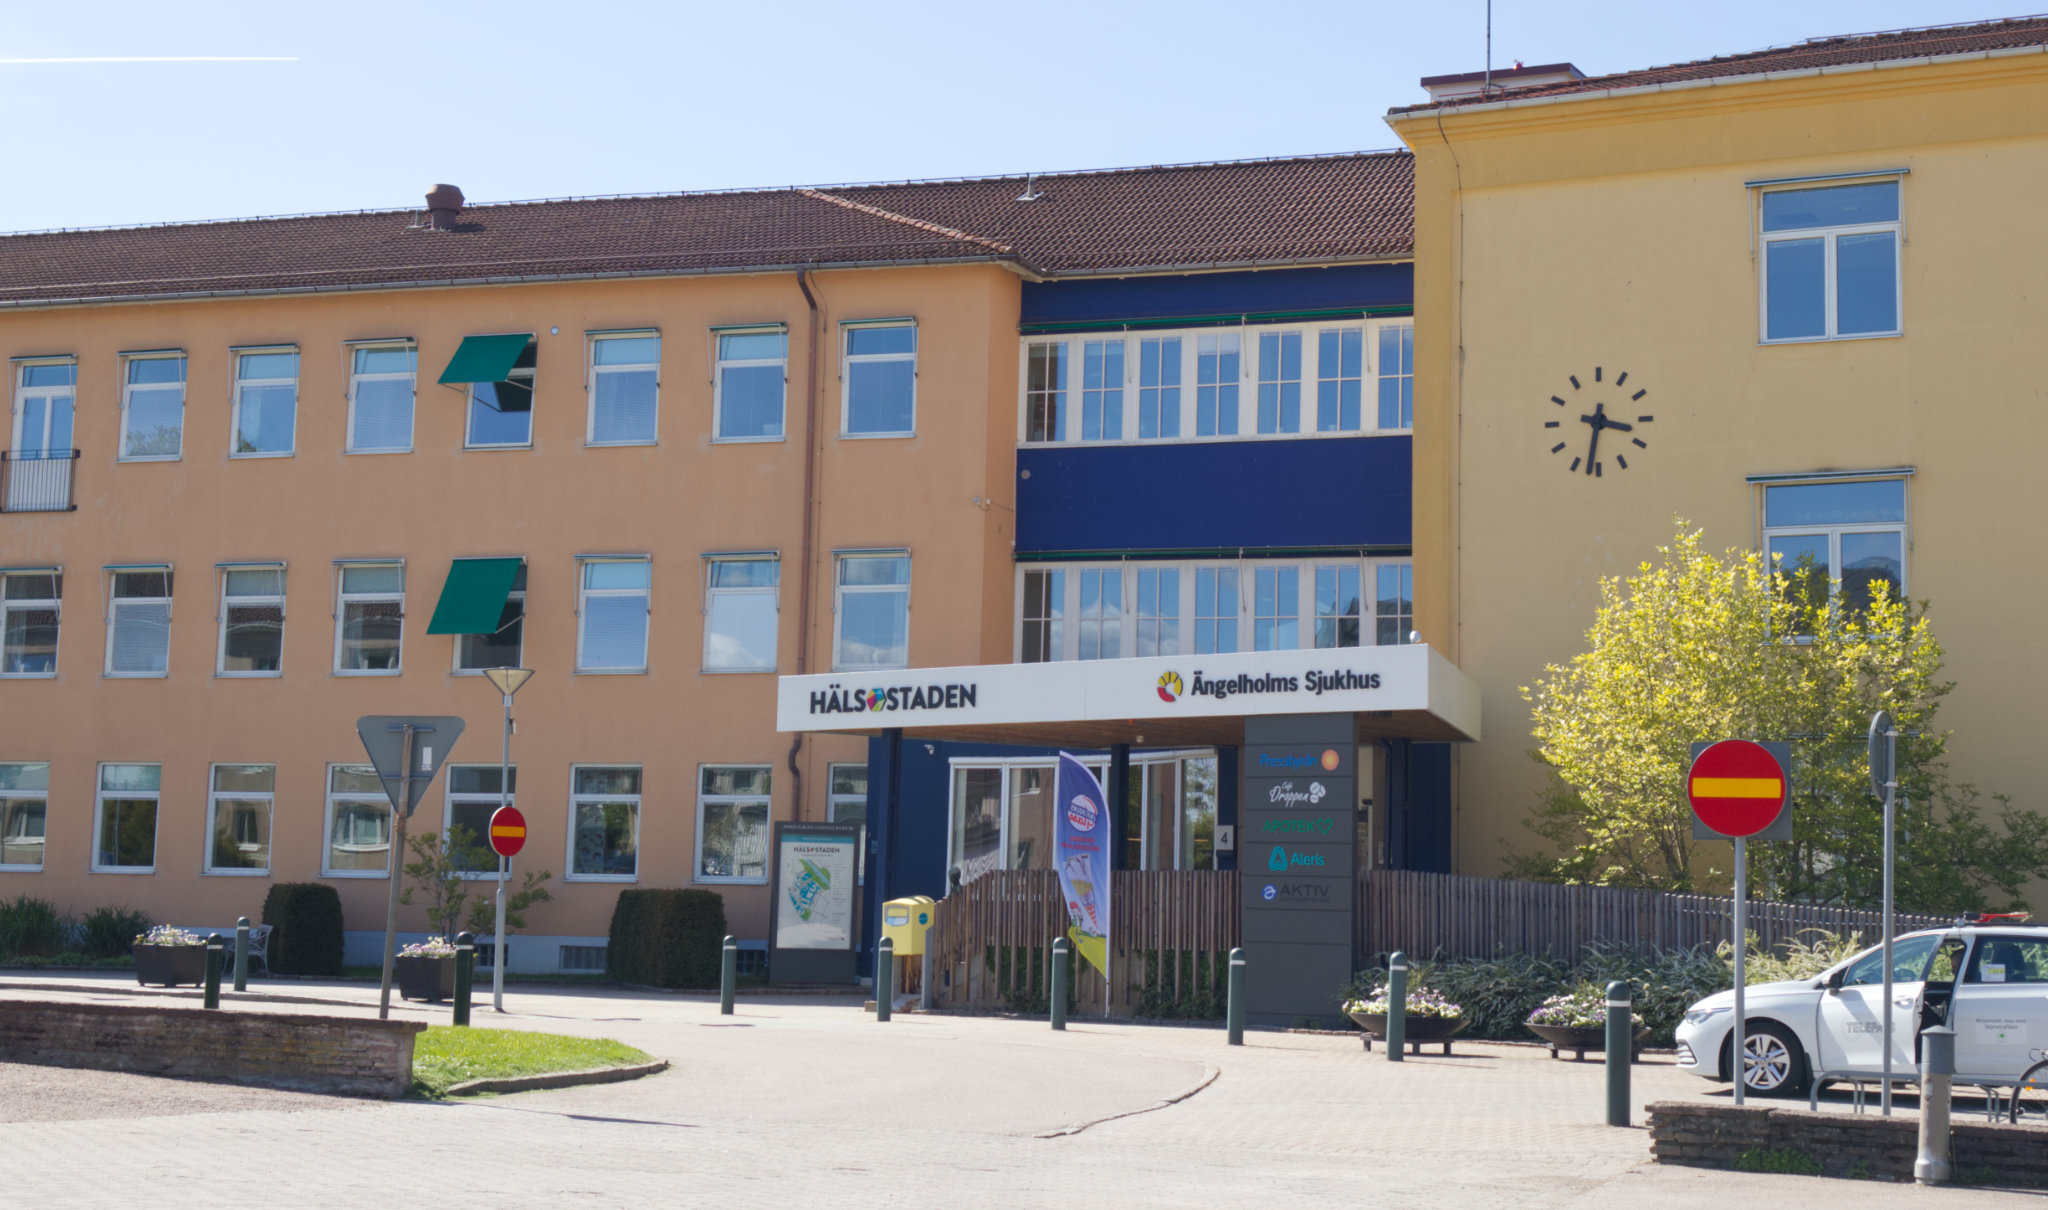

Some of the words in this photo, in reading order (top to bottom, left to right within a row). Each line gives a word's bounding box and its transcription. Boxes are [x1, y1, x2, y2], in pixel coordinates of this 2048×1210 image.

[1191, 671, 1299, 699] Ängelholms
[1304, 669, 1381, 696] Sjukhus
[1259, 753, 1318, 771] Pressbyrån
[1269, 785, 1310, 807] Droppen
[1262, 820, 1316, 833] APOTEK
[1220, 831, 1229, 845] 4
[1290, 852, 1325, 866] Aleris
[1279, 884, 1330, 897] AKTIV
